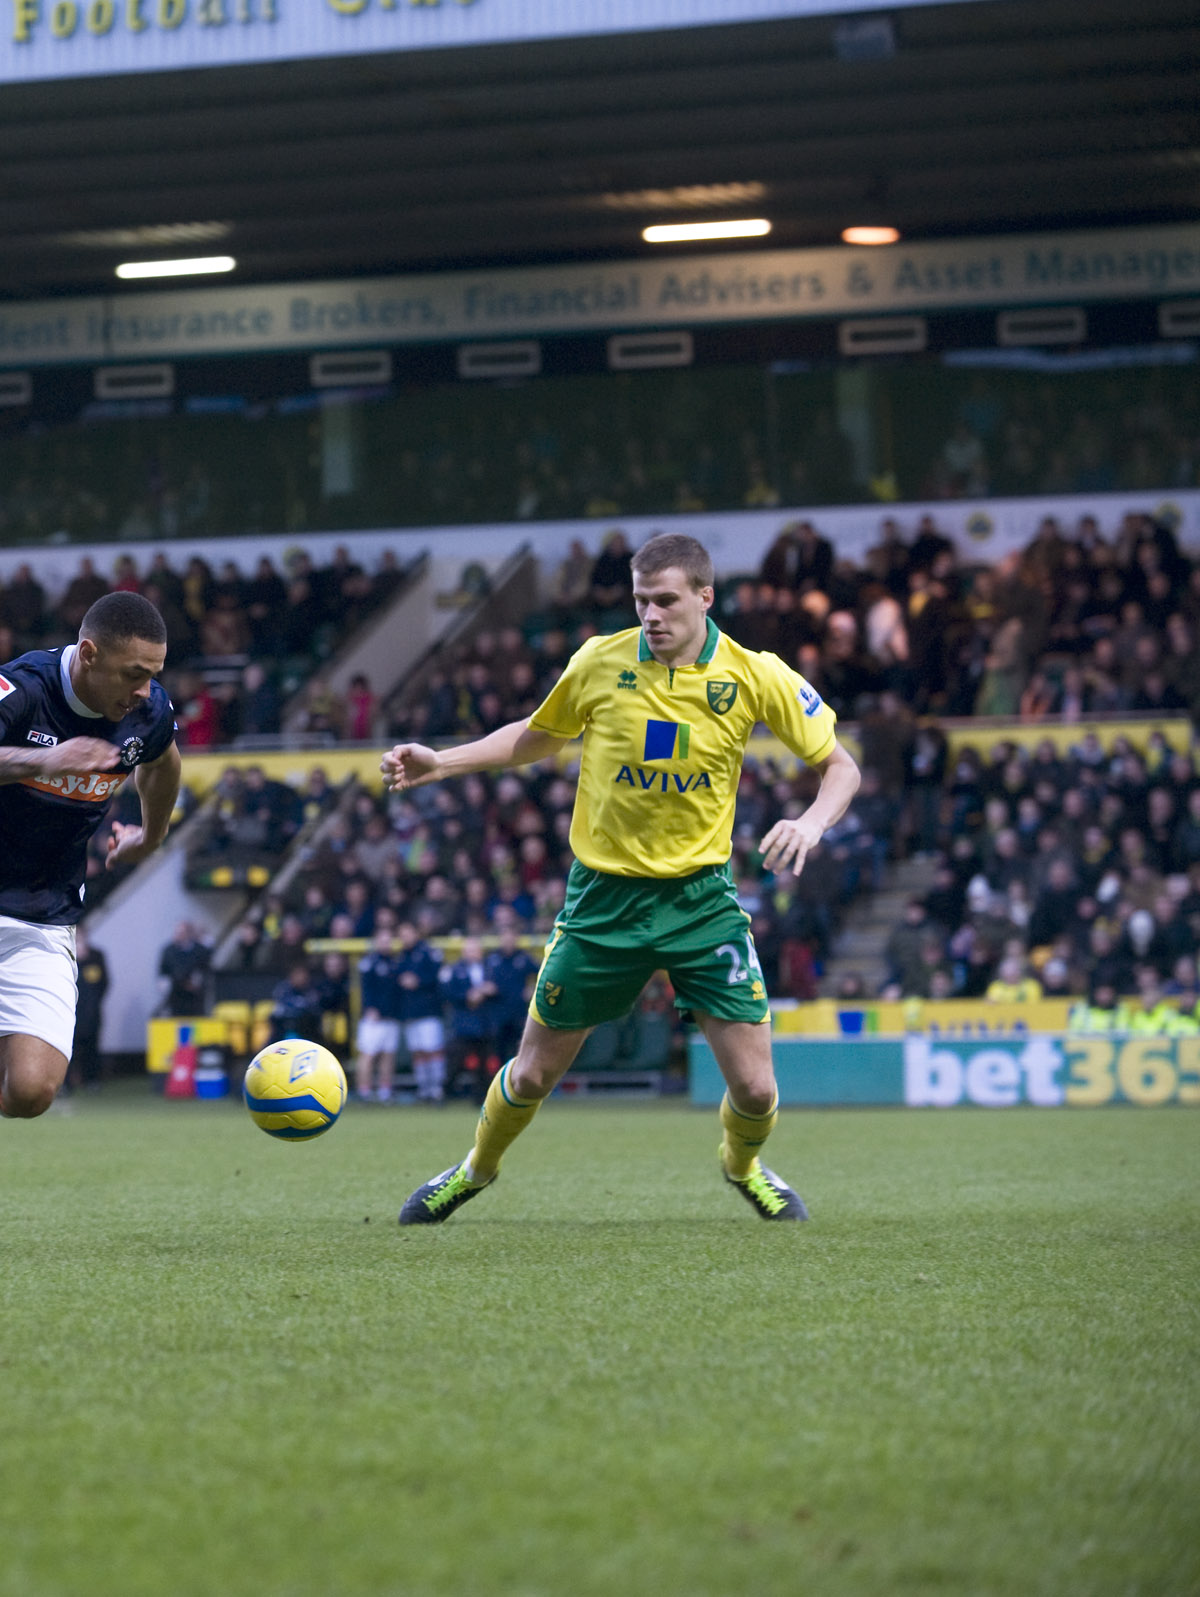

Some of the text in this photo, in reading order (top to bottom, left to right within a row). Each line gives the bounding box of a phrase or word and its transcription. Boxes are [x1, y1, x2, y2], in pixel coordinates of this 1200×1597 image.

[88, 302, 274, 343] Insurance
[464, 269, 641, 320] Financial
[660, 263, 823, 305] Advisers
[846, 261, 874, 294] &
[900, 253, 1002, 292] Asset
[29, 731, 55, 746] FILA
[615, 765, 711, 793] AVIVA
